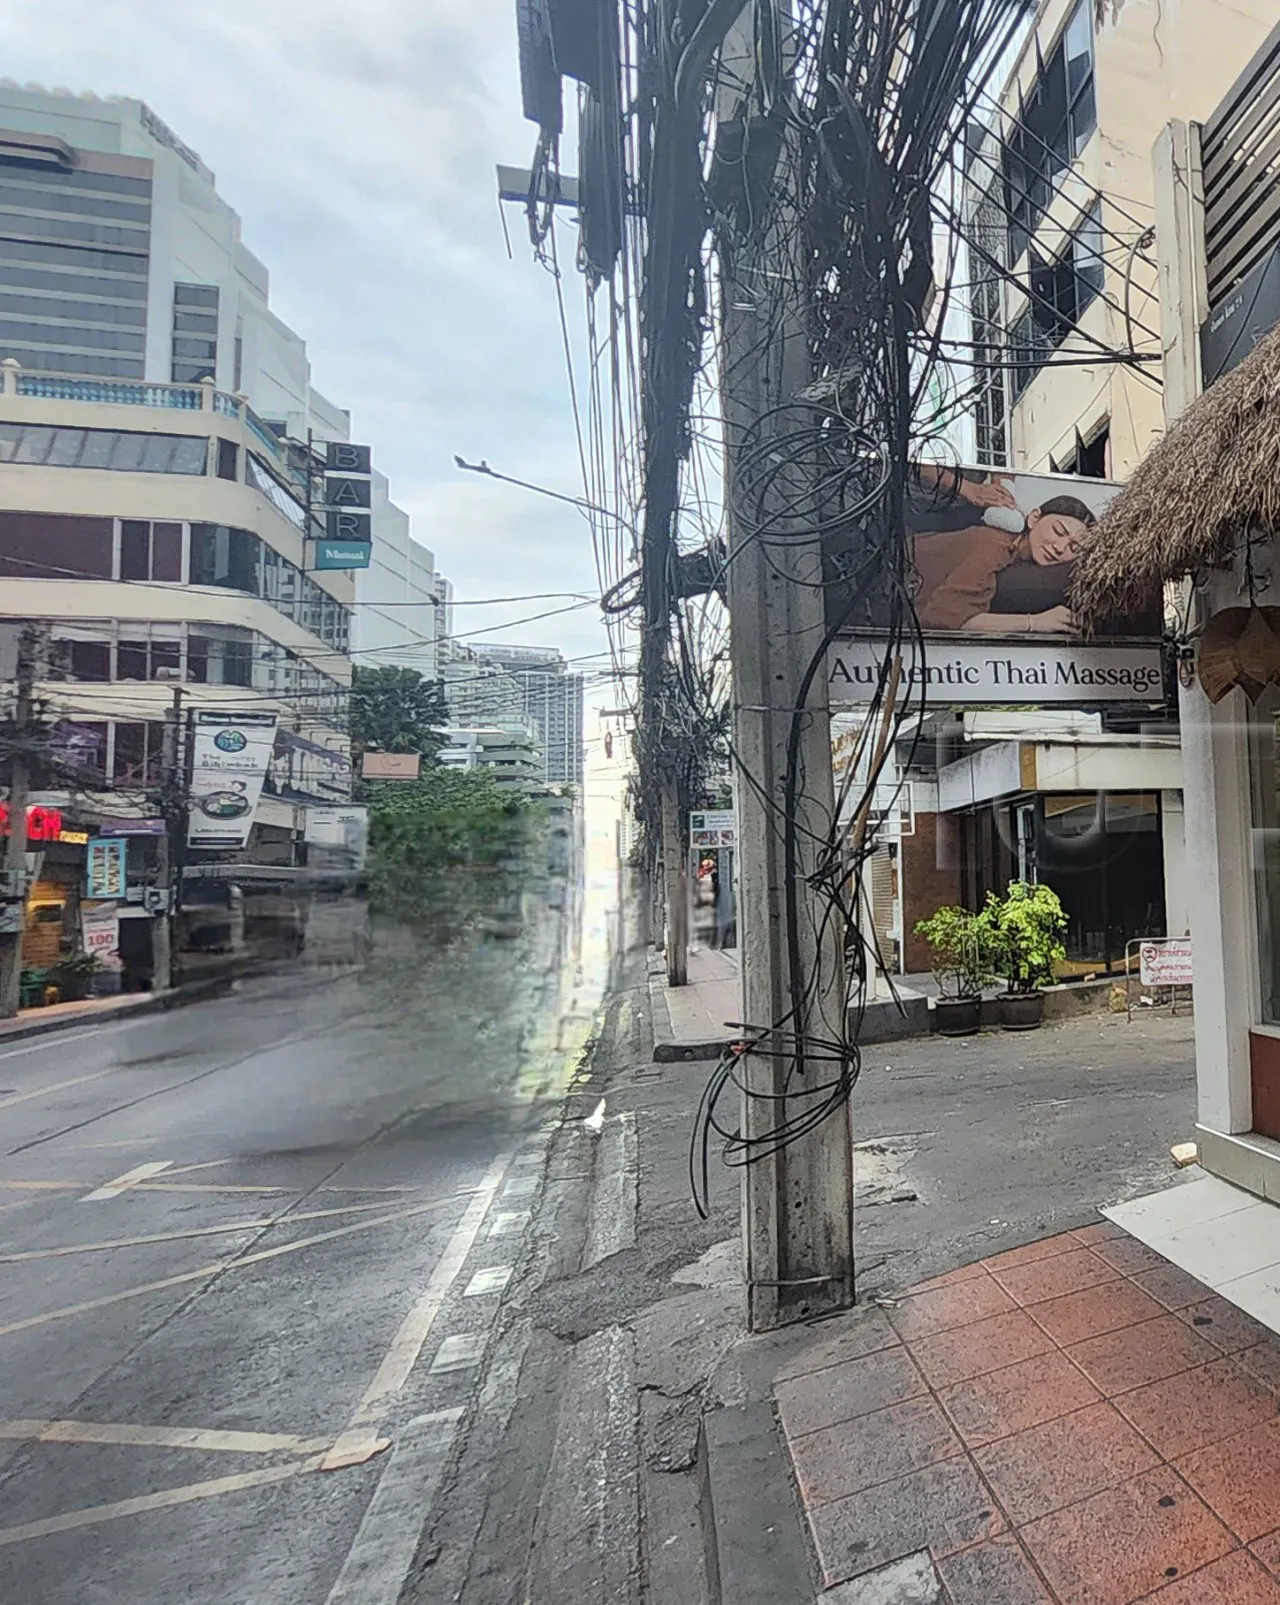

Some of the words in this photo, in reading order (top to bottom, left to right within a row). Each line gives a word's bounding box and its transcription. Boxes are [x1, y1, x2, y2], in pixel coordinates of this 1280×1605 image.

[335, 445, 360, 537] BAR
[829, 656, 979, 685] Authentic
[984, 659, 1047, 685] Thai
[1054, 661, 1161, 693] Massage
[88, 933, 114, 946] 100
